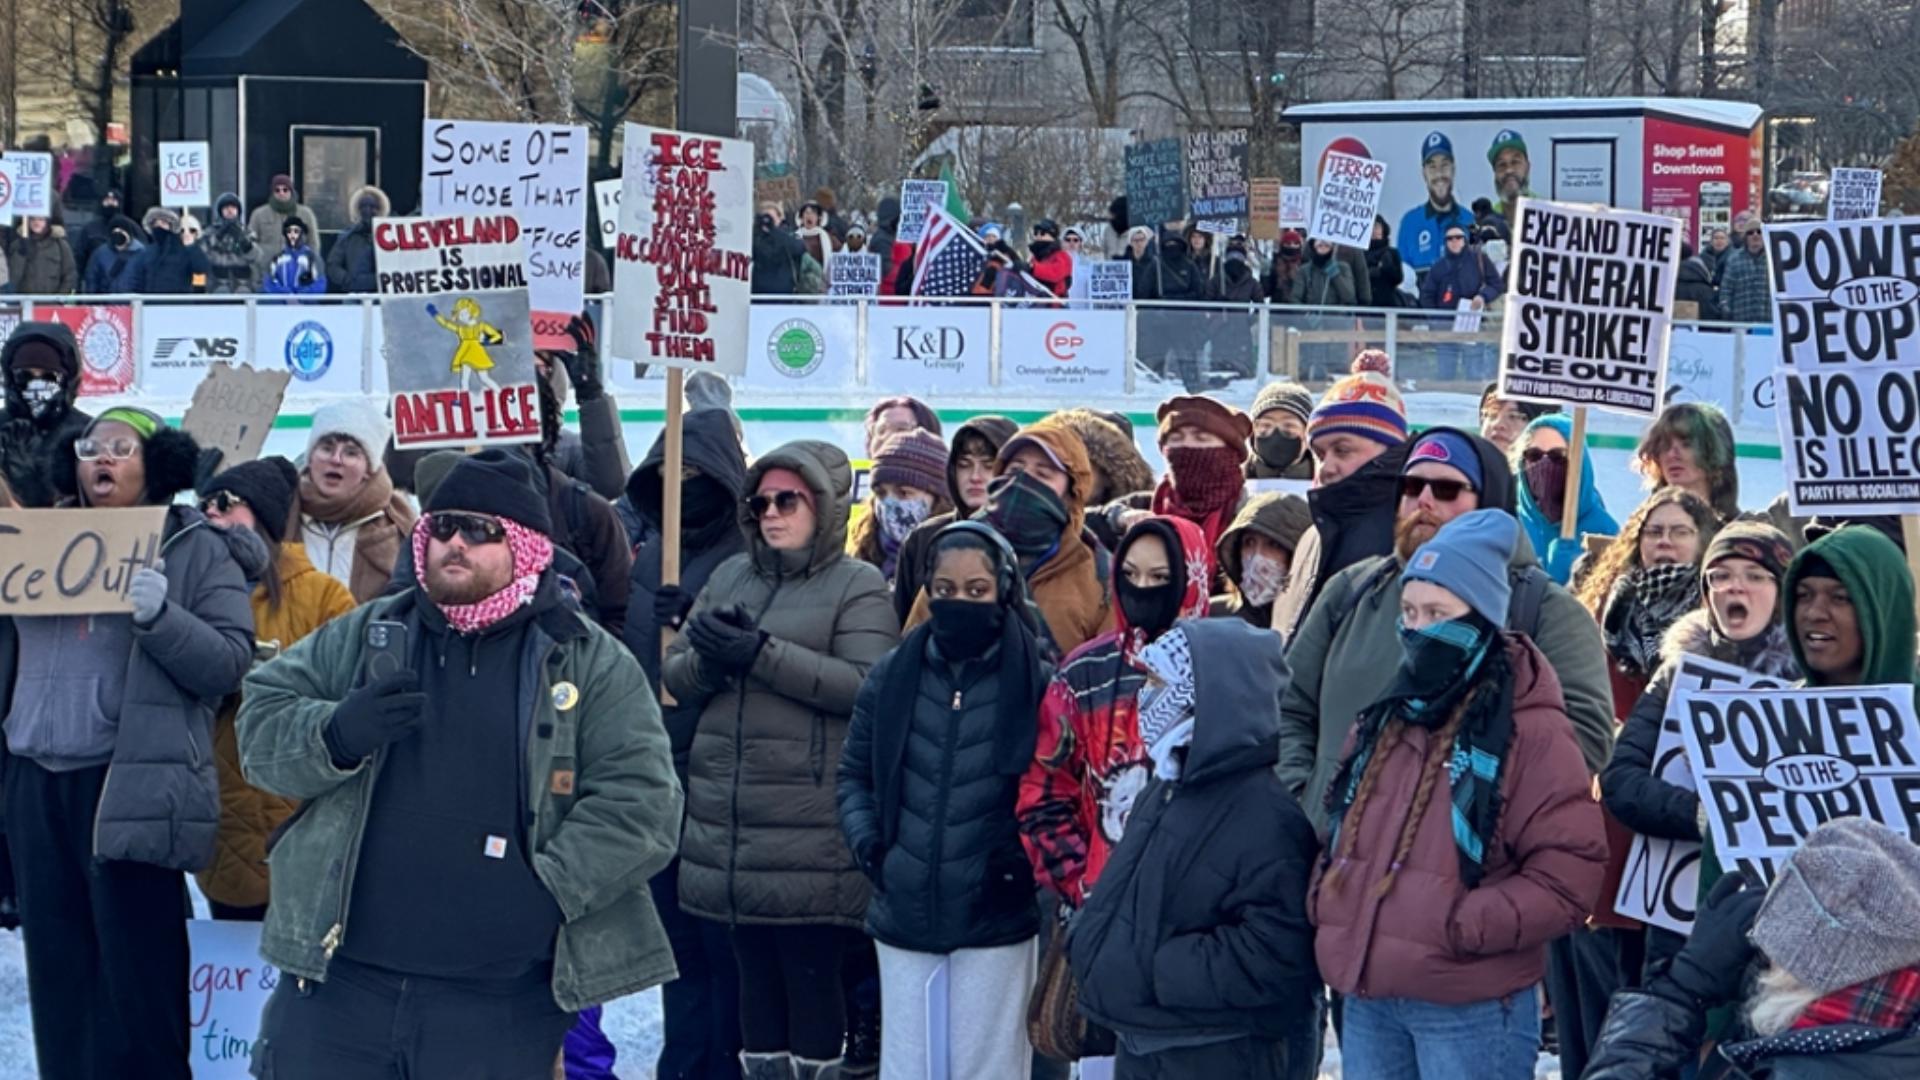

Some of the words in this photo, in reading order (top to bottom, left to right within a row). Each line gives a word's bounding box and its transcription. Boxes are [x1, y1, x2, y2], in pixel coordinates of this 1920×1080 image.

[432, 123, 511, 164] SOME
[527, 130, 571, 164] OF
[1210, 130, 1248, 146] WONDER
[168, 152, 200, 169] ICE
[1212, 145, 1230, 160] YOU
[1653, 144, 1686, 159] Shop
[1688, 144, 1724, 157] Small
[164, 170, 203, 192] OUT!
[1143, 163, 1180, 176] POWER
[1329, 155, 1383, 183] TERROR
[1653, 162, 1724, 174] Downtown
[1836, 170, 1848, 179] THE
[1852, 171, 1878, 180] WHOLE
[428, 169, 512, 206] THOSE
[519, 173, 581, 206] THAT
[1322, 183, 1376, 204] COHERENT
[1345, 176, 1361, 187] NOT
[1835, 186, 1843, 198] IS
[1846, 186, 1878, 200] GUILTY
[1143, 211, 1171, 224] YOU
[1319, 197, 1375, 218] IMMIGRATION
[374, 216, 519, 251] CLEVELAND
[652, 222, 715, 249] FACES
[1318, 212, 1369, 241] POLICY
[1521, 208, 1622, 255] EXPAND
[1626, 222, 1673, 264] THE
[440, 248, 463, 266] IS
[529, 252, 582, 279] SAME
[616, 233, 751, 282] ACCOUNTABILITY
[832, 255, 863, 266] EXPAND
[864, 255, 877, 266] THE
[1093, 263, 1103, 274] THE
[1105, 264, 1128, 275] WHOLE
[1769, 223, 1920, 292] POWE
[379, 263, 528, 293] PROFESSIONAL
[657, 263, 706, 290] WILL
[832, 268, 877, 282] GENERAL
[1092, 280, 1099, 291] IS
[1101, 280, 1128, 292] GUILTY
[1517, 248, 1664, 314] GENERAL
[654, 285, 717, 313] STILL
[831, 284, 873, 295] STRIKE!
[1844, 285, 1866, 306] TO
[1869, 281, 1903, 304] THE
[653, 308, 707, 334] FIND
[1518, 303, 1651, 365] STRIKE!
[1778, 300, 1920, 364] PEOP
[188, 338, 238, 358] NS
[645, 331, 715, 361] THEM
[892, 325, 965, 360] K&D
[924, 356, 965, 372] Group
[1507, 353, 1563, 376] ICE
[1569, 361, 1657, 389] OUT!
[1507, 377, 1533, 392] PARTY
[1533, 380, 1548, 393] FOR
[1548, 381, 1595, 398] SOCIALISM
[1595, 387, 1606, 401] &
[1606, 388, 1653, 408] LIBERATION
[1786, 372, 1861, 437] NO
[395, 384, 540, 435] ANTI-ICE
[1794, 437, 1828, 480] IS
[1799, 485, 1835, 501] PARTY
[1836, 485, 1857, 500] FOR
[1860, 481, 1920, 499] SOCIALISM
[1687, 697, 1915, 769] POWER
[1776, 764, 1801, 786] TO
[1807, 760, 1843, 783] THE
[258, 965, 276, 991] &
[202, 1018, 249, 1062] tim
